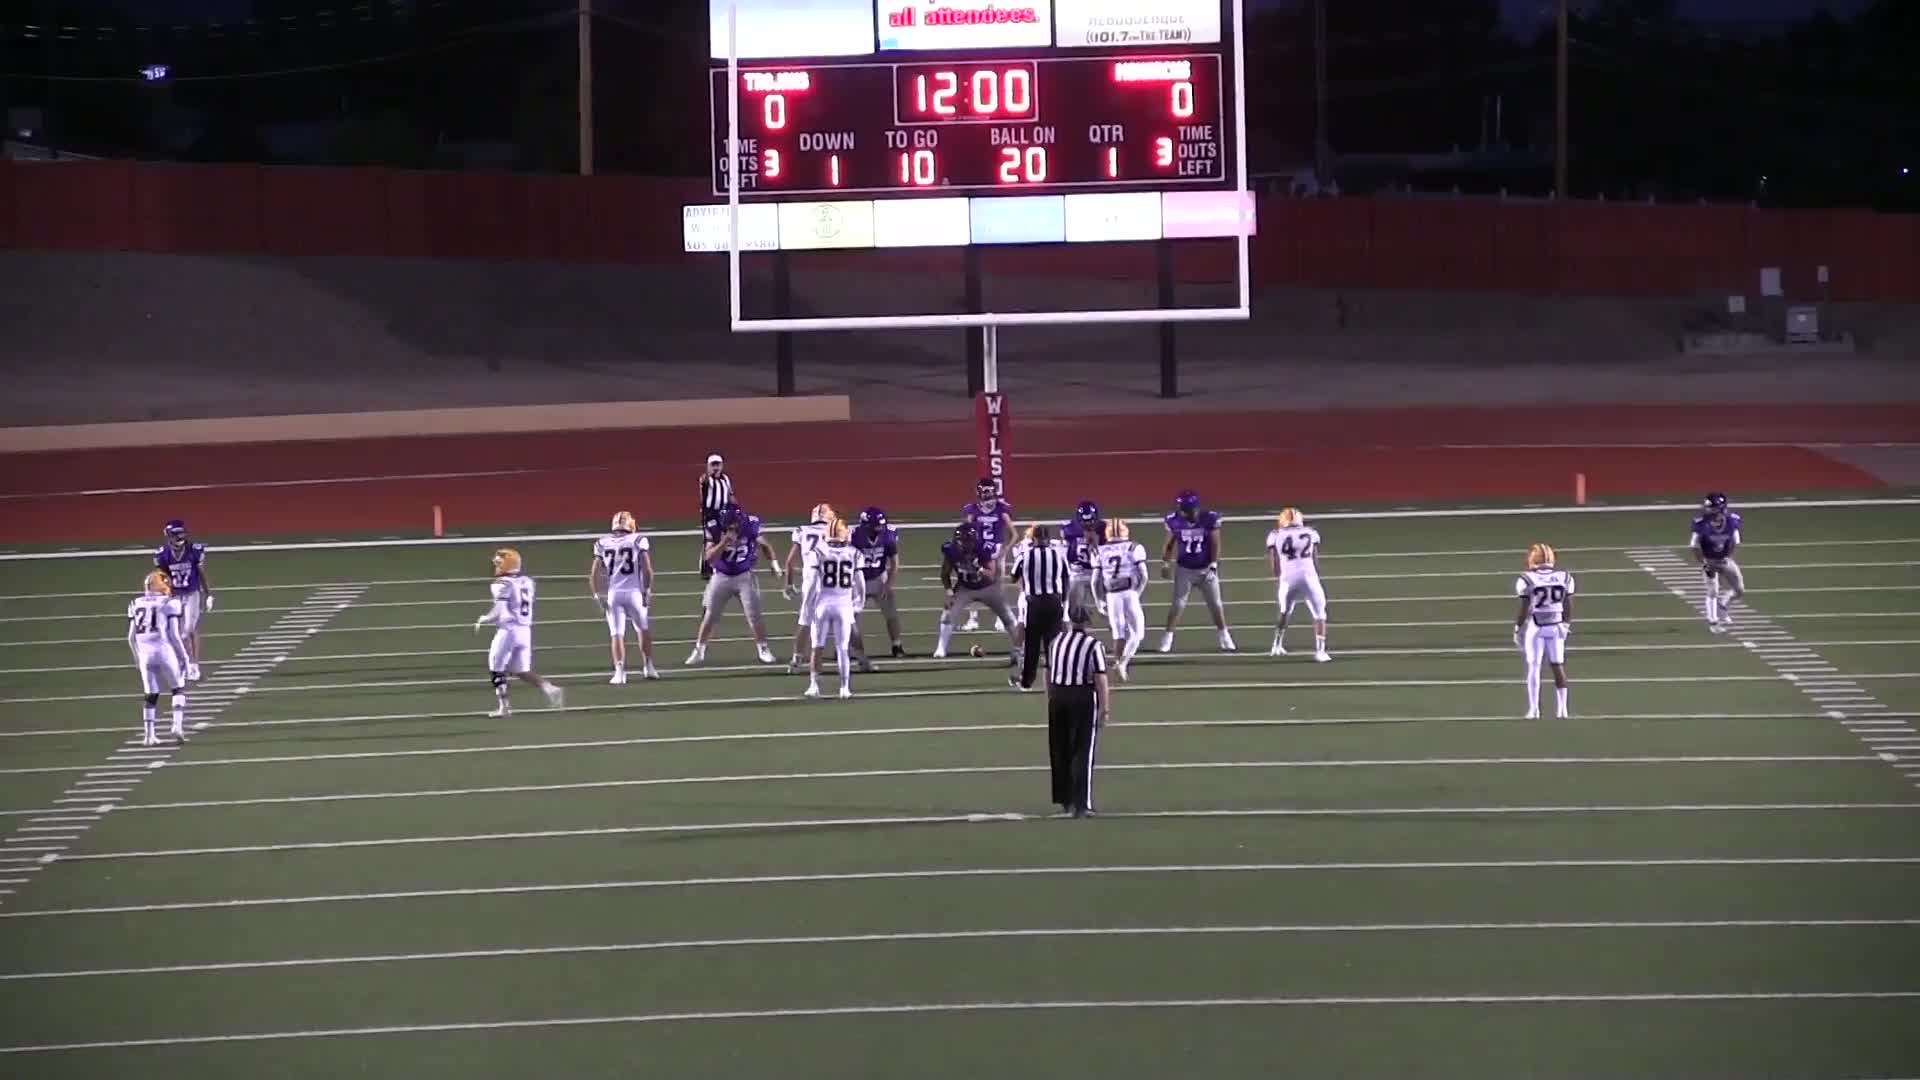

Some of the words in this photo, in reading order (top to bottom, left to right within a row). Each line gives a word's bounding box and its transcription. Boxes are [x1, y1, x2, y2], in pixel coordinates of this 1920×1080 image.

[890, 7, 915, 26] all
[925, 7, 1040, 25] attendees.
[917, 69, 1031, 114] 12:00
[1172, 82, 1193, 116] 0
[763, 94, 786, 129] 0
[799, 132, 855, 151] DOWN
[885, 131, 907, 149] TO
[913, 130, 938, 148] GO
[990, 126, 1029, 145] BALL
[1033, 125, 1055, 144] ON
[1089, 124, 1124, 142] QTR
[1178, 125, 1212, 141] TIME
[722, 138, 758, 154] TME
[1156, 136, 1173, 166] 3
[1178, 142, 1216, 158] OUTS
[719, 156, 758, 172] OTS
[764, 149, 779, 177] 3
[831, 154, 839, 186] 1
[901, 150, 935, 185] 10
[1000, 146, 1048, 182] 20
[1109, 146, 1117, 178] 1
[1178, 159, 1213, 175] LEFT
[723, 173, 758, 188] LFT
[726, 545, 749, 562] 72
[1181, 535, 1204, 554] 77
[1281, 533, 1312, 560] 42
[605, 549, 635, 576] 73
[822, 560, 852, 589] 86
[1108, 555, 1123, 580] 7
[134, 606, 160, 634] 21
